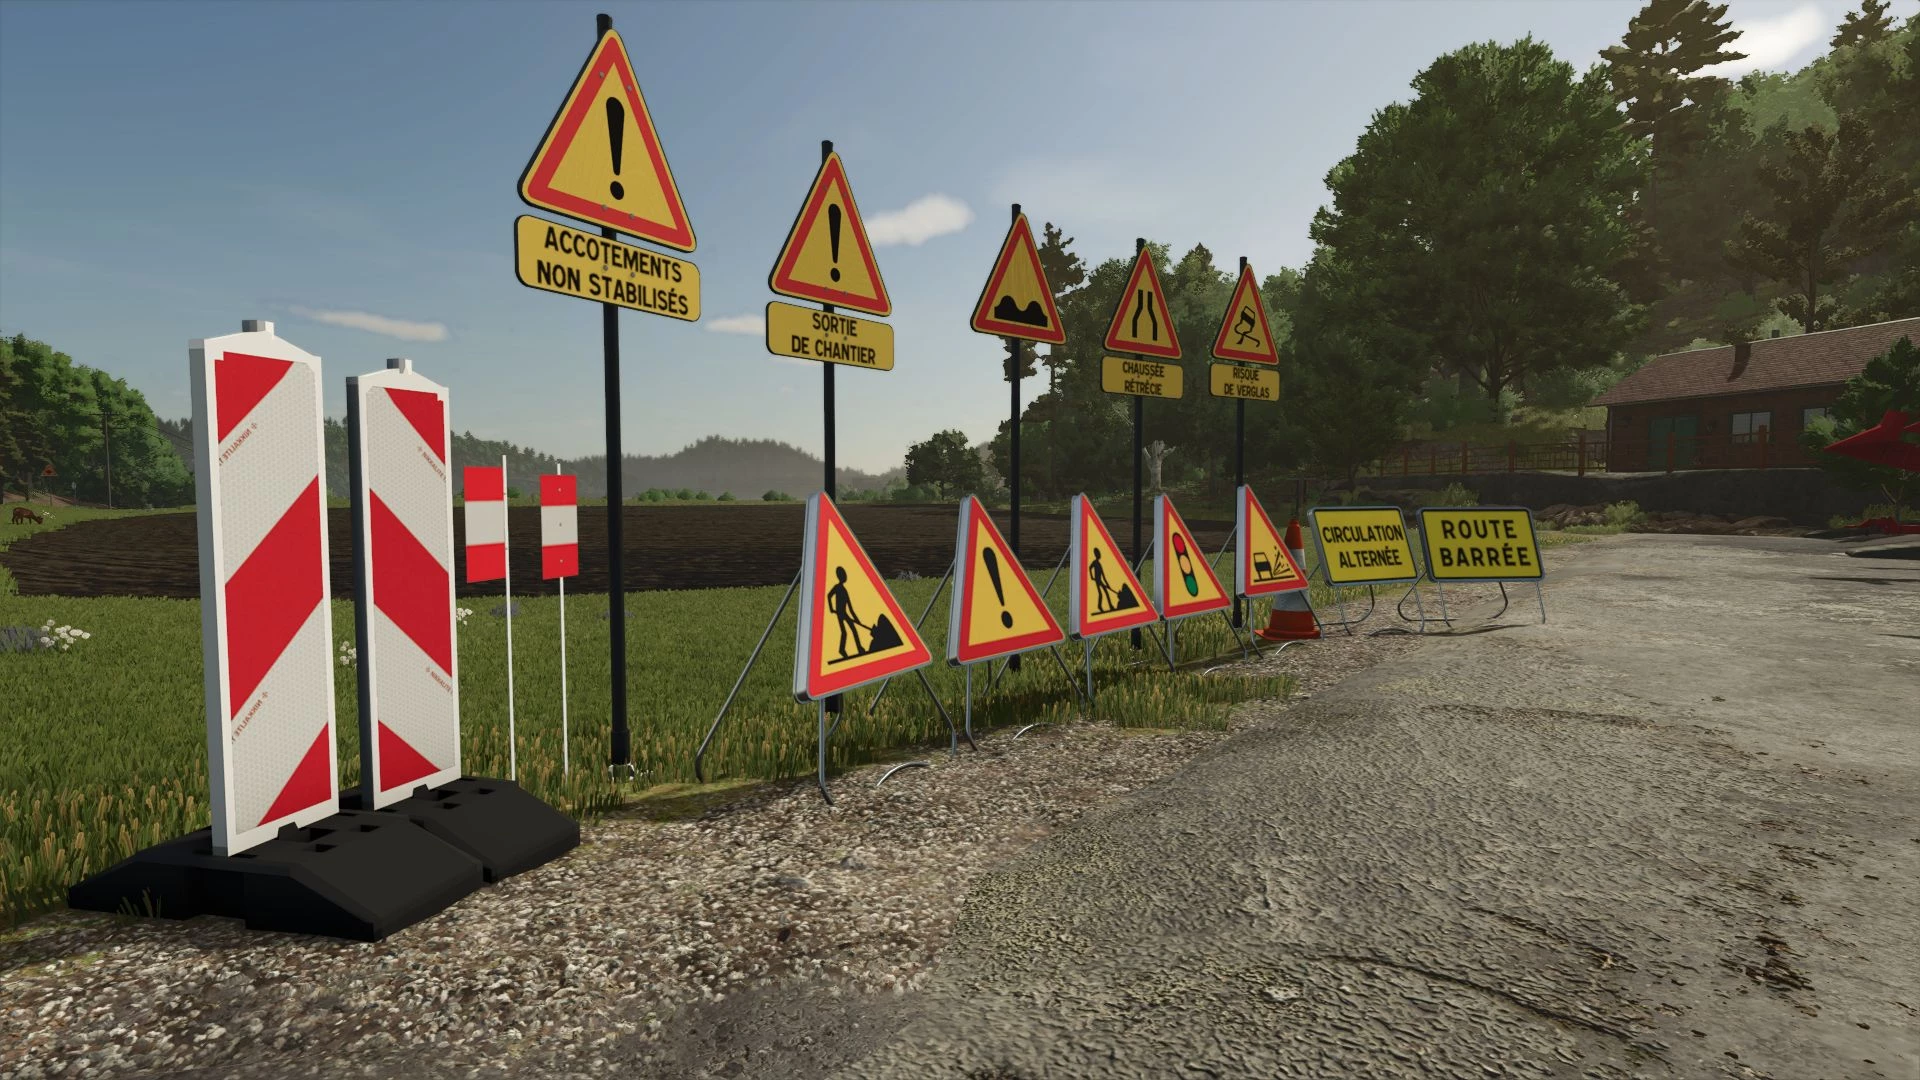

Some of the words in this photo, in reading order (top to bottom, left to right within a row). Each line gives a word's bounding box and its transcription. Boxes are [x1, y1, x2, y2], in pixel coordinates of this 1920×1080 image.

[544, 226, 682, 283] ACCOTEMENTS
[537, 259, 581, 292] NON
[589, 273, 689, 315] STABILISÉS
[812, 312, 857, 337] SORTIE
[791, 335, 809, 354] DE
[815, 339, 876, 365] CHANTIER
[1122, 361, 1165, 378] CHAUSSÉE
[1233, 367, 1259, 381] RISQUE
[1224, 383, 1234, 396] DE
[1237, 385, 1270, 399] VERGLAS
[1322, 524, 1404, 544] CIRCULATION
[1441, 519, 1517, 540] ROUTE
[1339, 546, 1403, 569] ALTERNÉE
[1440, 543, 1531, 567] BARRÉE
